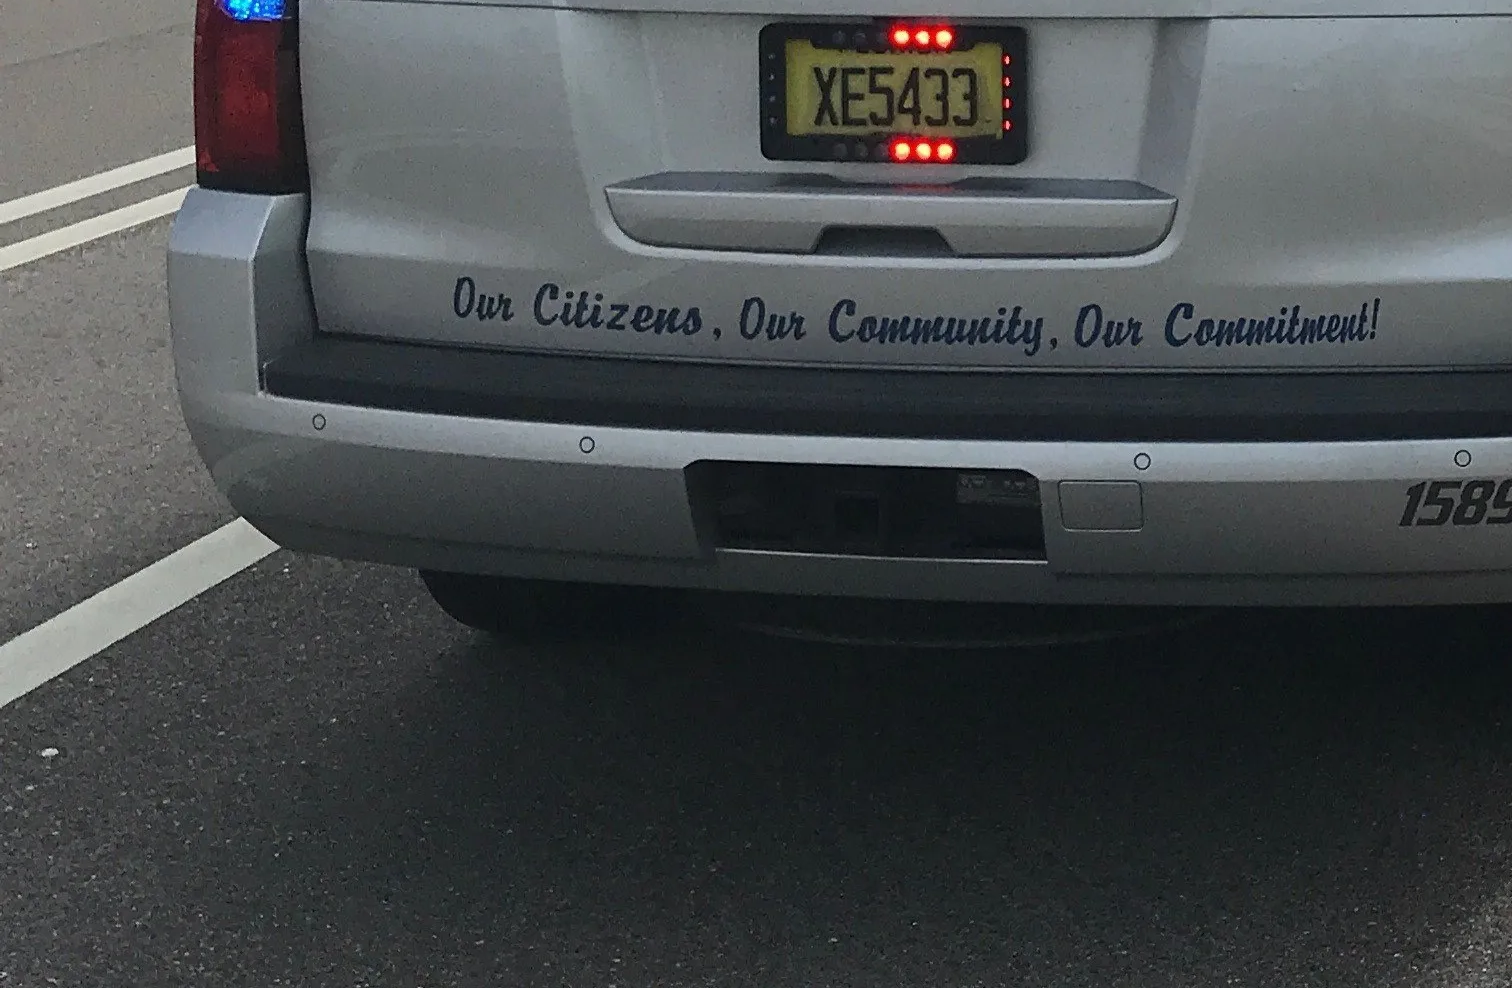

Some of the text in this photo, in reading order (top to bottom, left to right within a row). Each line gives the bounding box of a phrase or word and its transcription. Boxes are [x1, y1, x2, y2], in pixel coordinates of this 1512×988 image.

[813, 66, 978, 127] XE5433
[453, 276, 514, 322] Our
[739, 295, 806, 342] Our
[1074, 303, 1144, 349] Our
[1164, 298, 1381, 348] Commitment!
